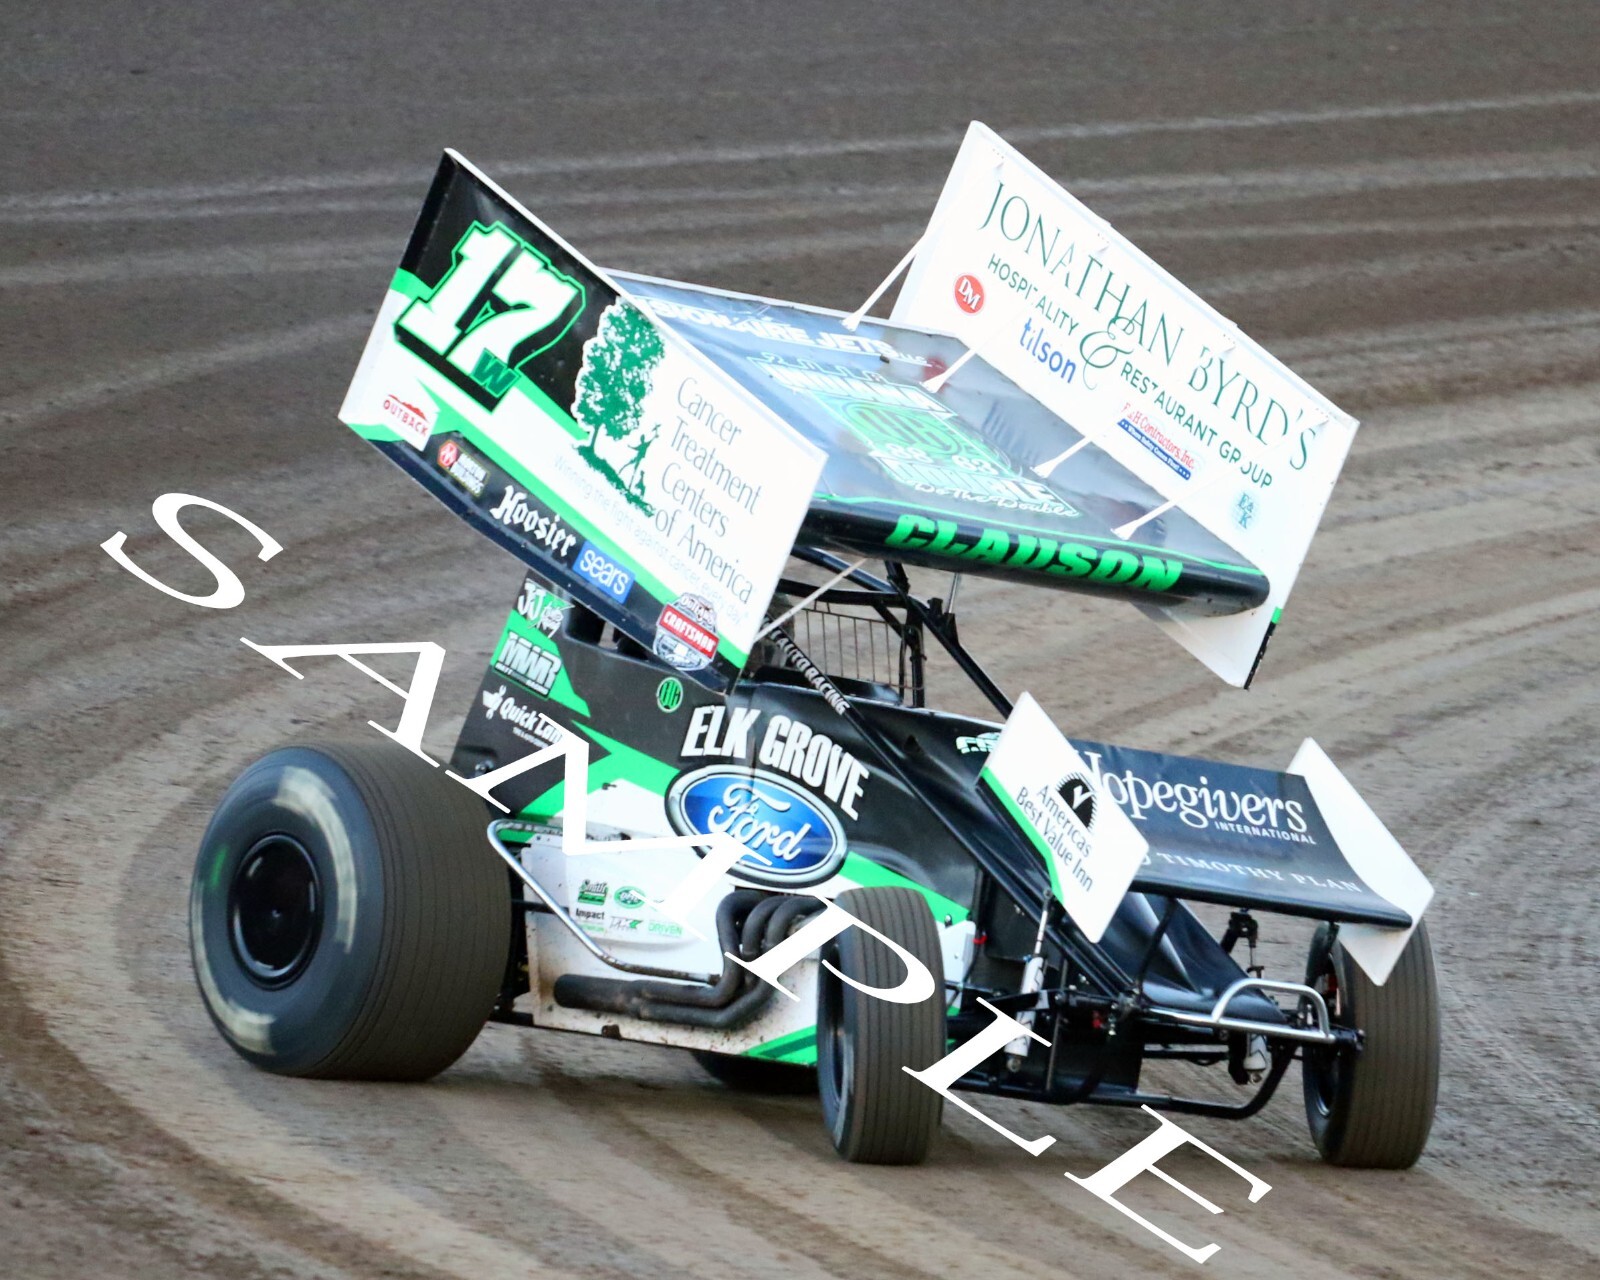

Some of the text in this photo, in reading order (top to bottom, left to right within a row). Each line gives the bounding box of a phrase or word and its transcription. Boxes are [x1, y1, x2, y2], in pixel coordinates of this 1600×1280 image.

[393, 219, 585, 412] 17
[978, 182, 1317, 470] JONATHAN BYRD'S
[987, 253, 1080, 336] HOSPIALITY
[470, 347, 522, 398] W
[817, 332, 899, 359] JETS
[1019, 317, 1077, 384] tilson
[383, 399, 428, 437] OUTBACK
[676, 376, 742, 446] Cancer
[660, 461, 731, 538] Centers
[669, 415, 762, 515] Treatment
[1218, 440, 1272, 489] GROUP
[490, 484, 577, 557] Hoosier
[884, 513, 1184, 592] CLAUSON
[579, 547, 631, 596] sears
[654, 508, 754, 605] of America
[661, 611, 717, 653] CRAFTSMAN
[500, 697, 539, 731] Quick
[533, 717, 565, 745] Lan
[680, 704, 870, 821] ELK GROVE
[707, 783, 812, 861] Ford
[1015, 786, 1094, 893] Best Value Inn
[1036, 784, 1093, 859] Americas
[1214, 820, 1317, 845] INTERNATIONAL
[1156, 852, 1281, 881] TIMOTHY
[1290, 872, 1363, 894] PLAN
[575, 907, 605, 920] Impact
